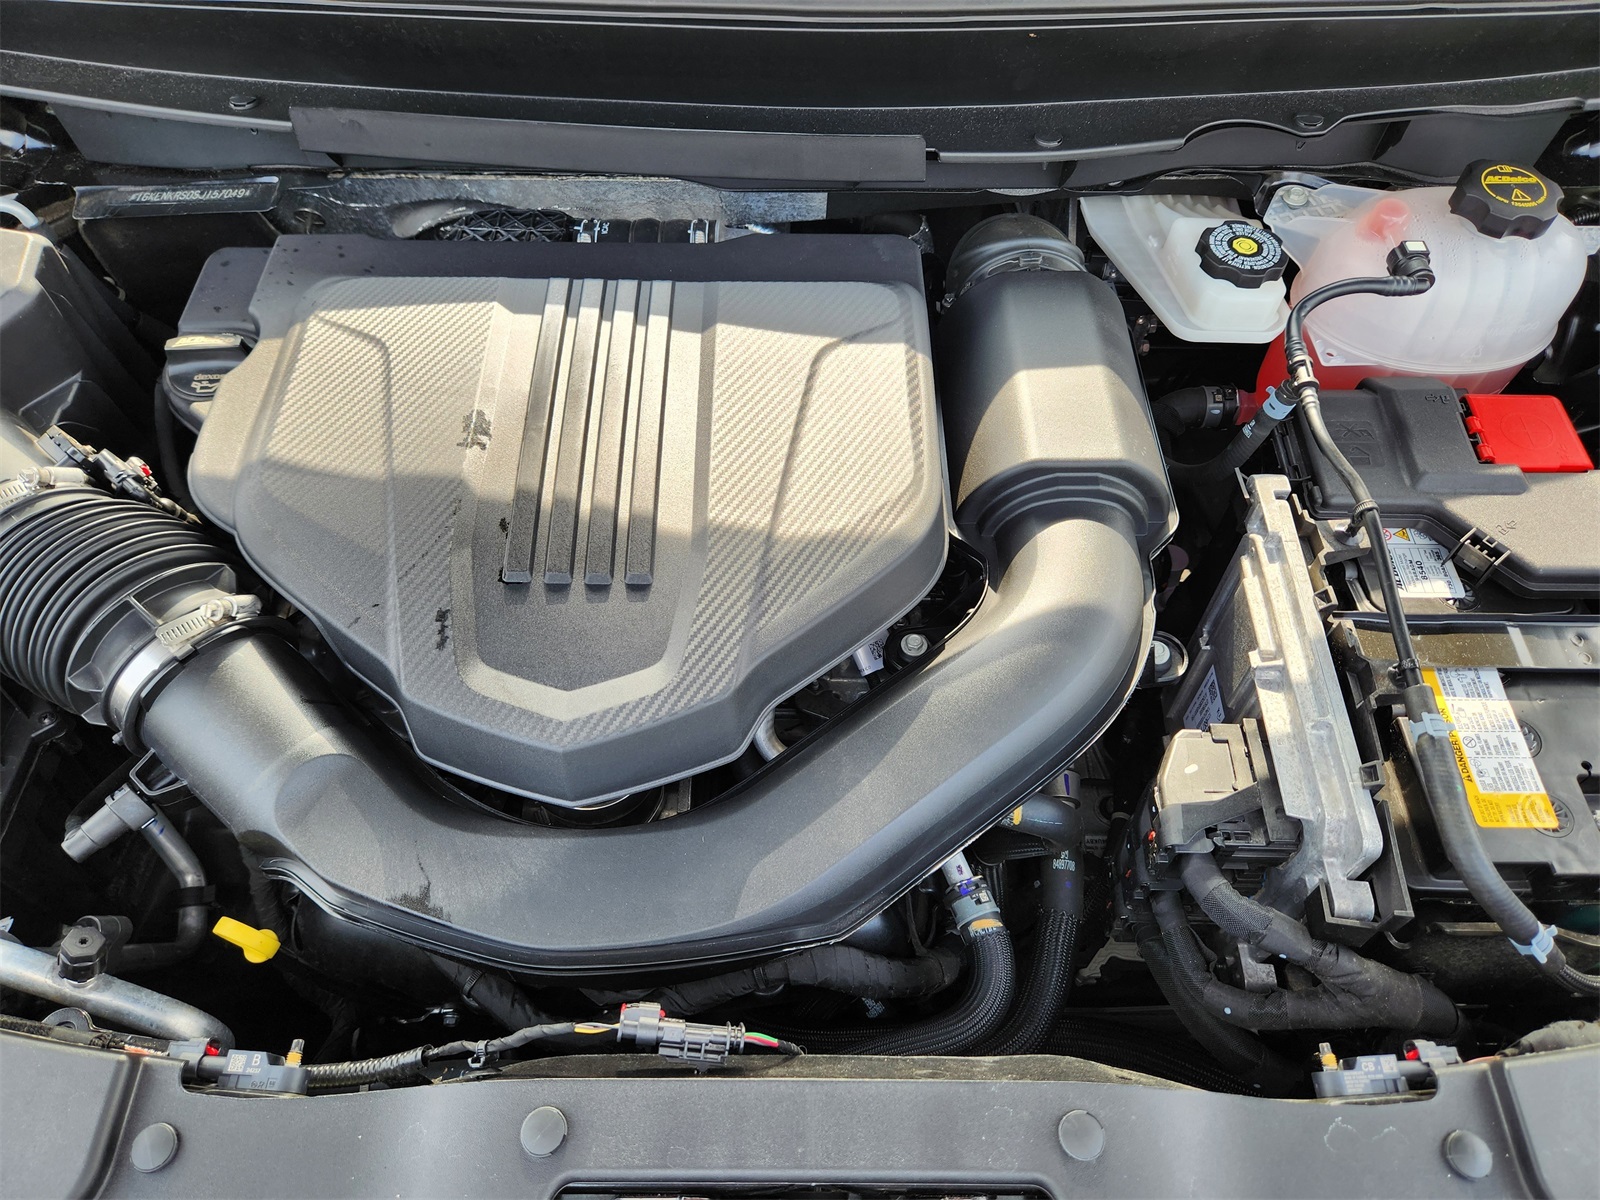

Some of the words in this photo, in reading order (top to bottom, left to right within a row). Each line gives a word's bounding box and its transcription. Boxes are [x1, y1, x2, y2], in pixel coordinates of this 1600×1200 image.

[1485, 175, 1537, 183] ACDelco
[1415, 560, 1428, 580] 8540
[252, 1053, 261, 1066] B
